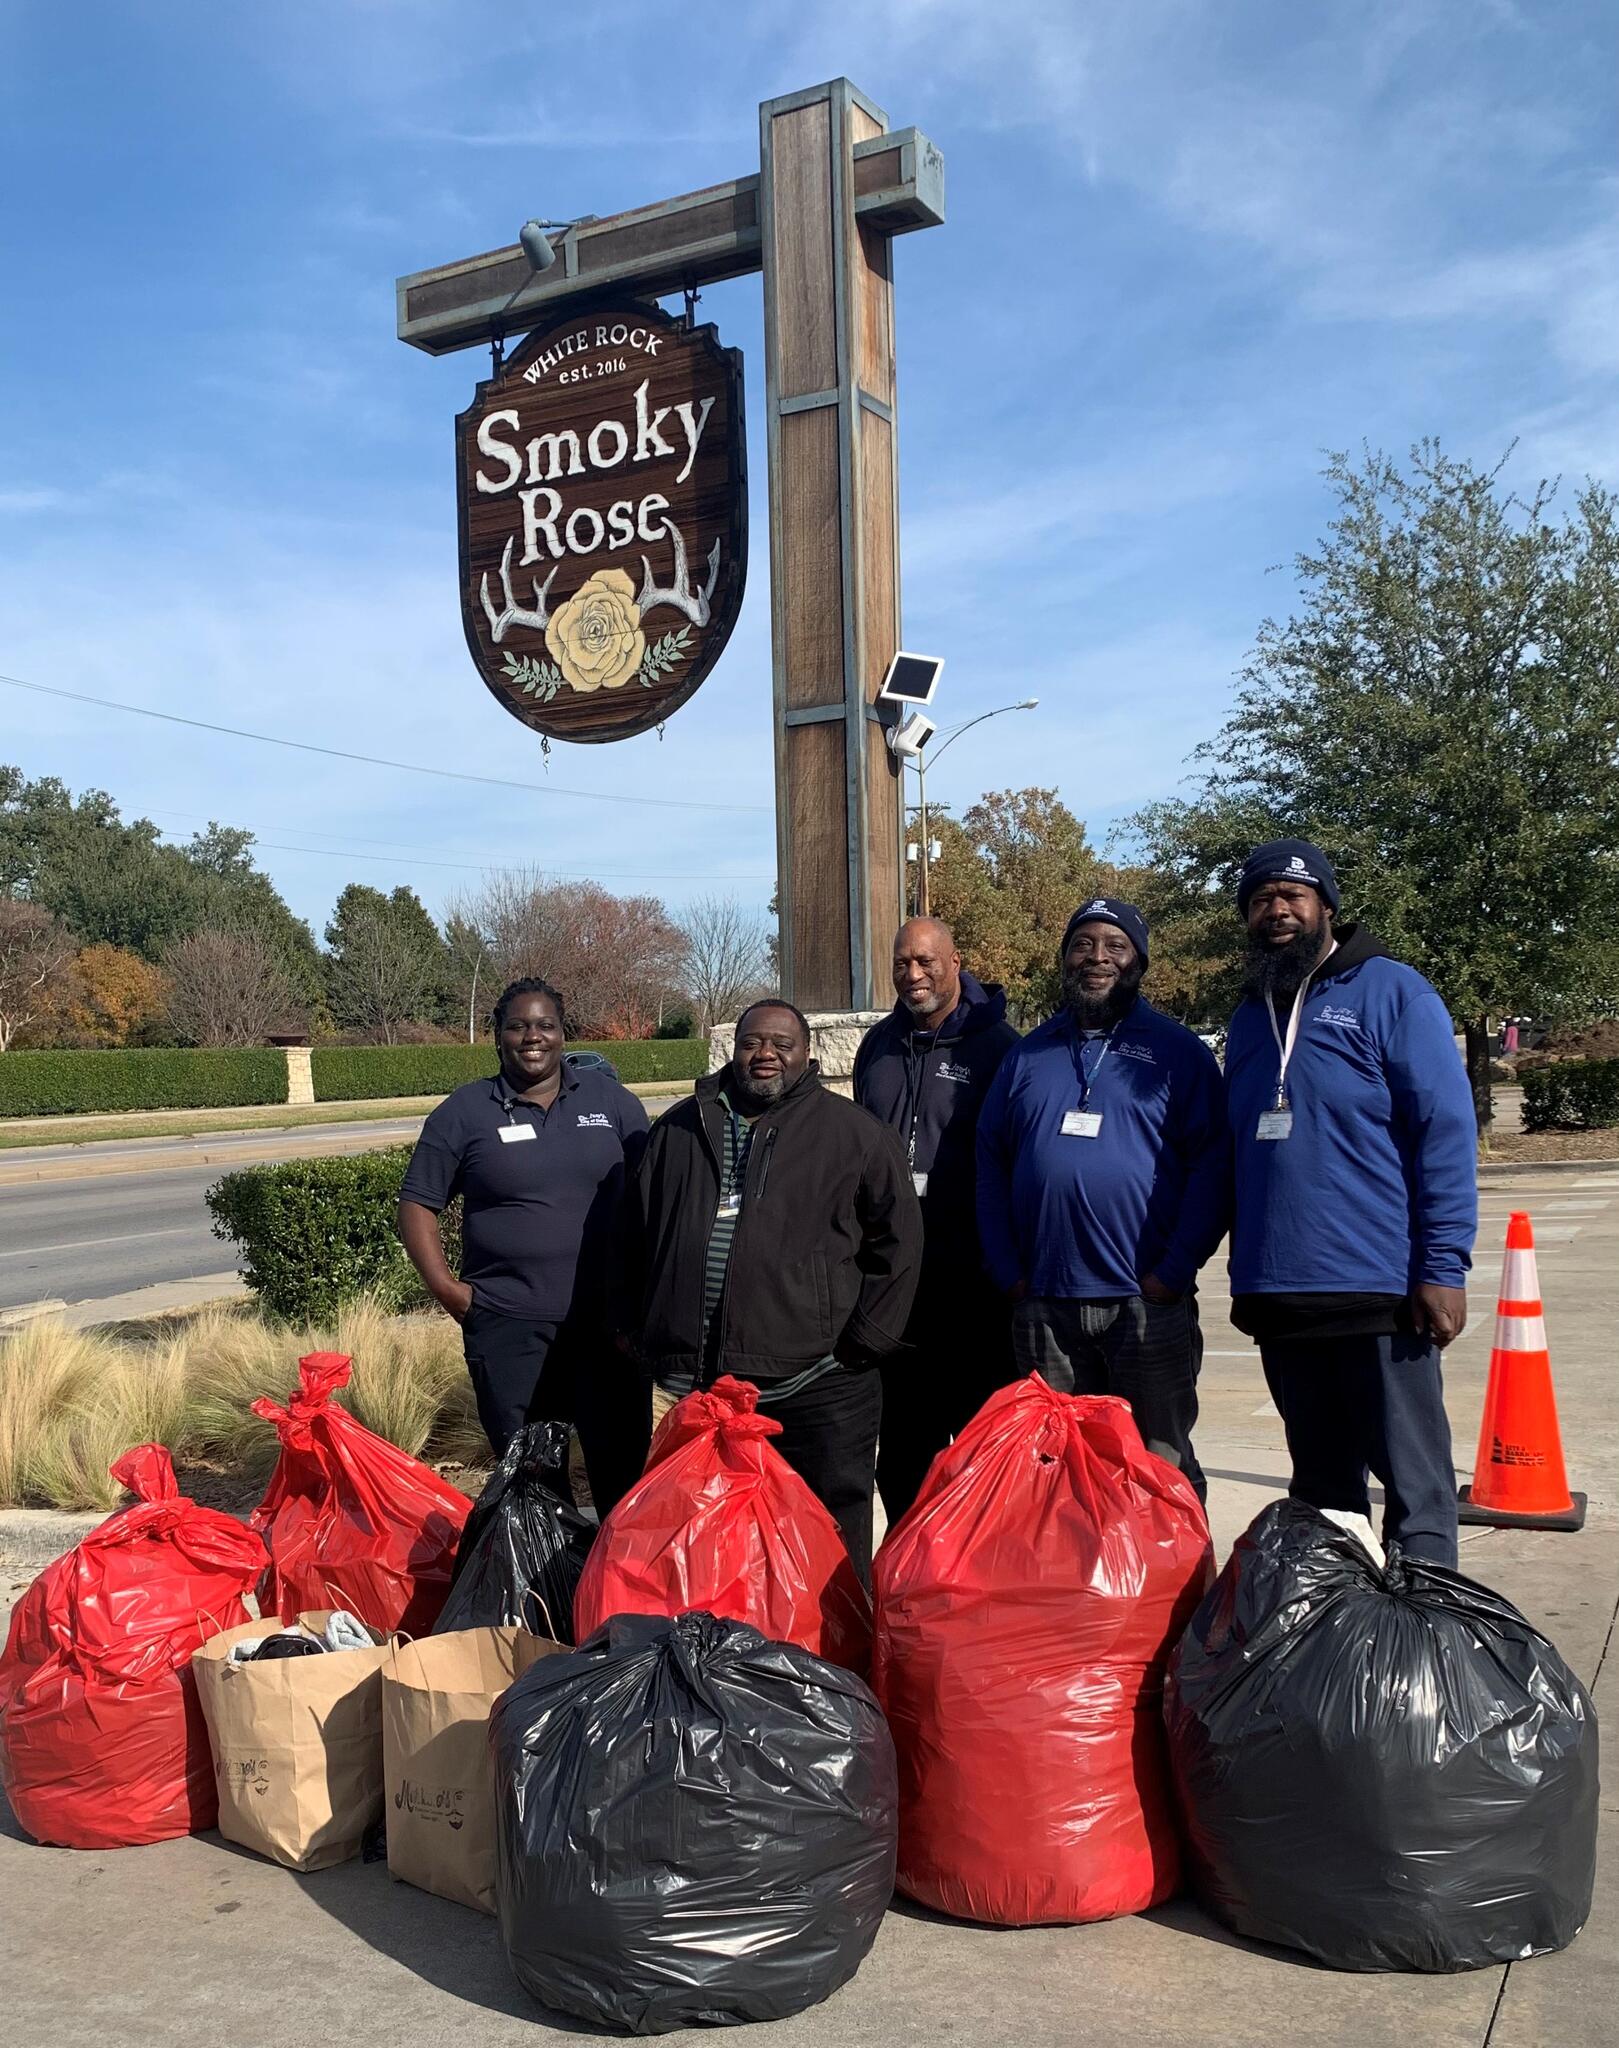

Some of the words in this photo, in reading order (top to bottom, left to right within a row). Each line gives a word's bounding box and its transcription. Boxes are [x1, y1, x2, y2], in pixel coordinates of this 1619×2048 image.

[522, 330, 588, 384] WHITE
[595, 324, 663, 356] ROCK
[559, 364, 592, 384] est.
[596, 357, 626, 376] 2016
[475, 378, 716, 493] Smoky
[518, 487, 670, 566] Rose
[1321, 1012, 1332, 1020] City
